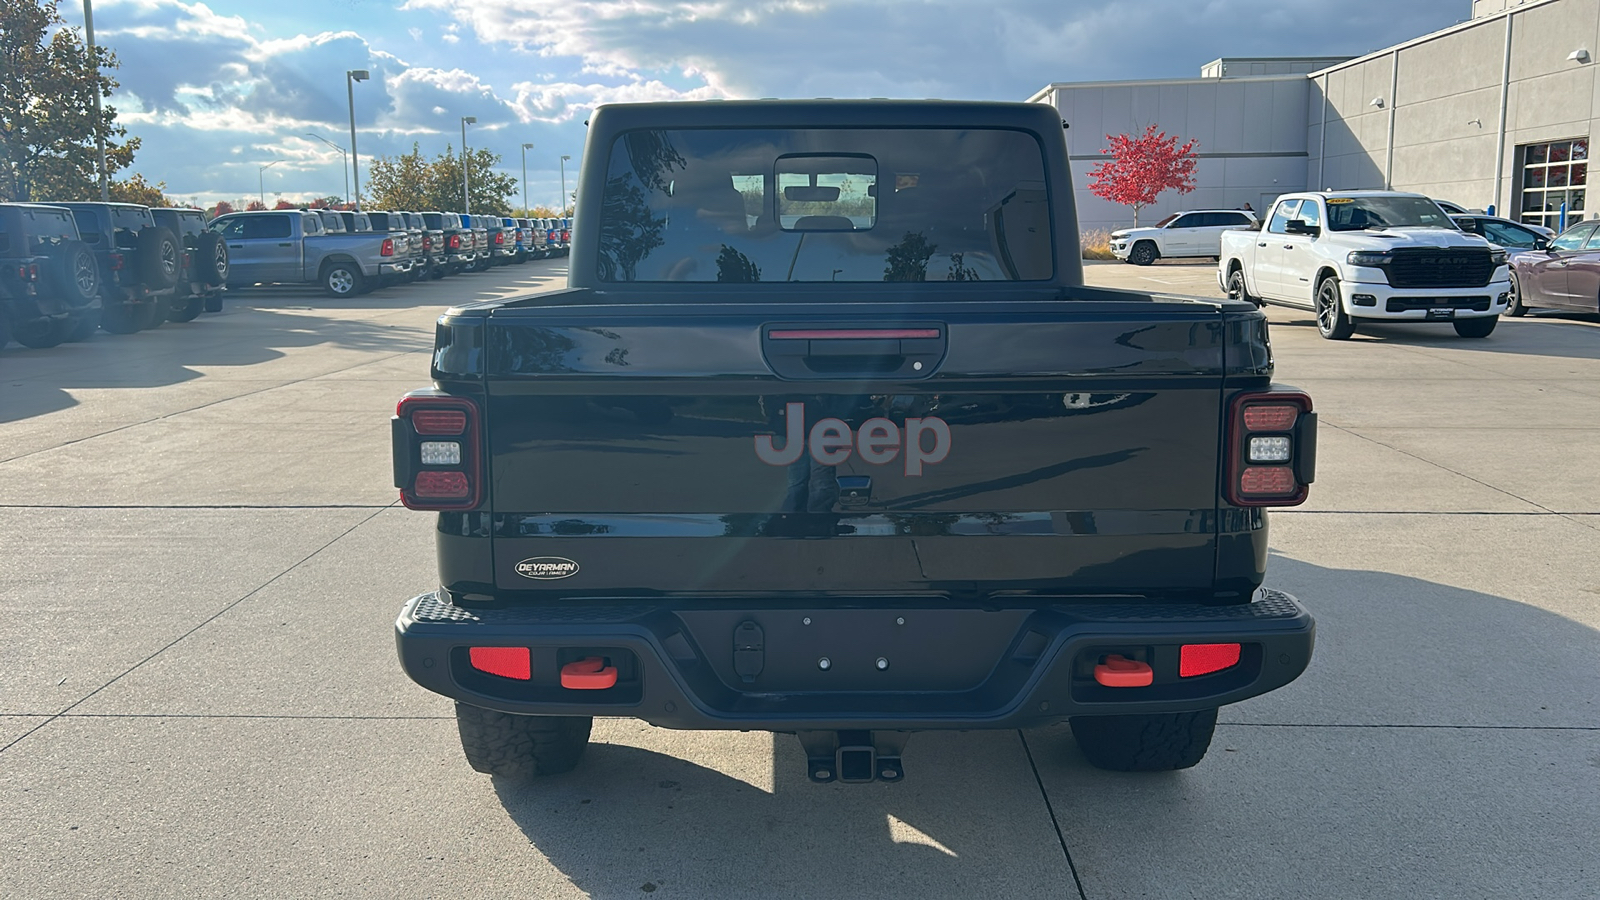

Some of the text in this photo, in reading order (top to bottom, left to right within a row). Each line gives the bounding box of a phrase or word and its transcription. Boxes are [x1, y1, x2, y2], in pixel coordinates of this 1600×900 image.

[1420, 257, 1469, 265] RAM
[754, 402, 951, 477] Jeep
[518, 563, 575, 571] DEYARMAN
